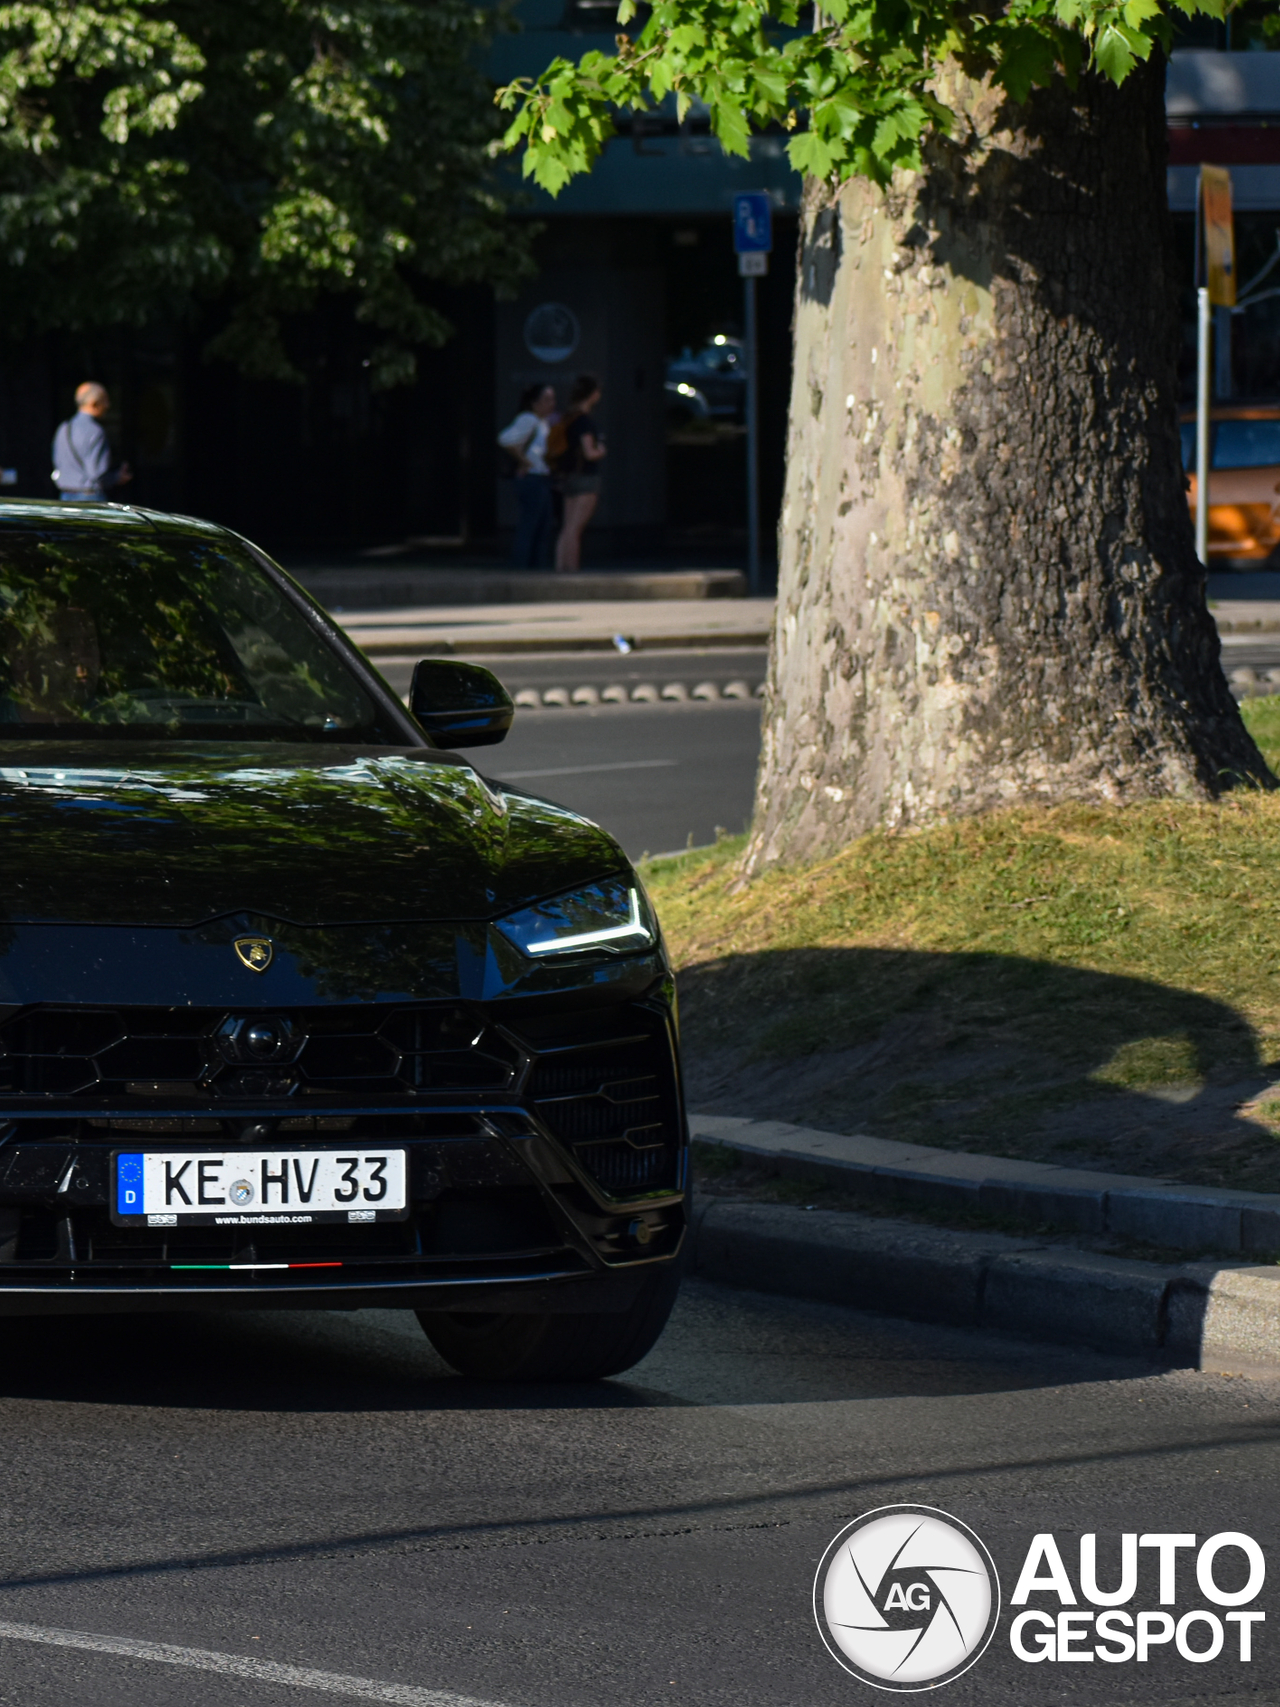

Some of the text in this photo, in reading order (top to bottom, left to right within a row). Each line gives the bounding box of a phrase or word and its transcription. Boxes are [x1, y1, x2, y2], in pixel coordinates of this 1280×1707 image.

[164, 1157, 388, 1206] KE HV 33
[125, 1190, 136, 1204] D
[215, 1214, 312, 1225] www.bundsauto.com
